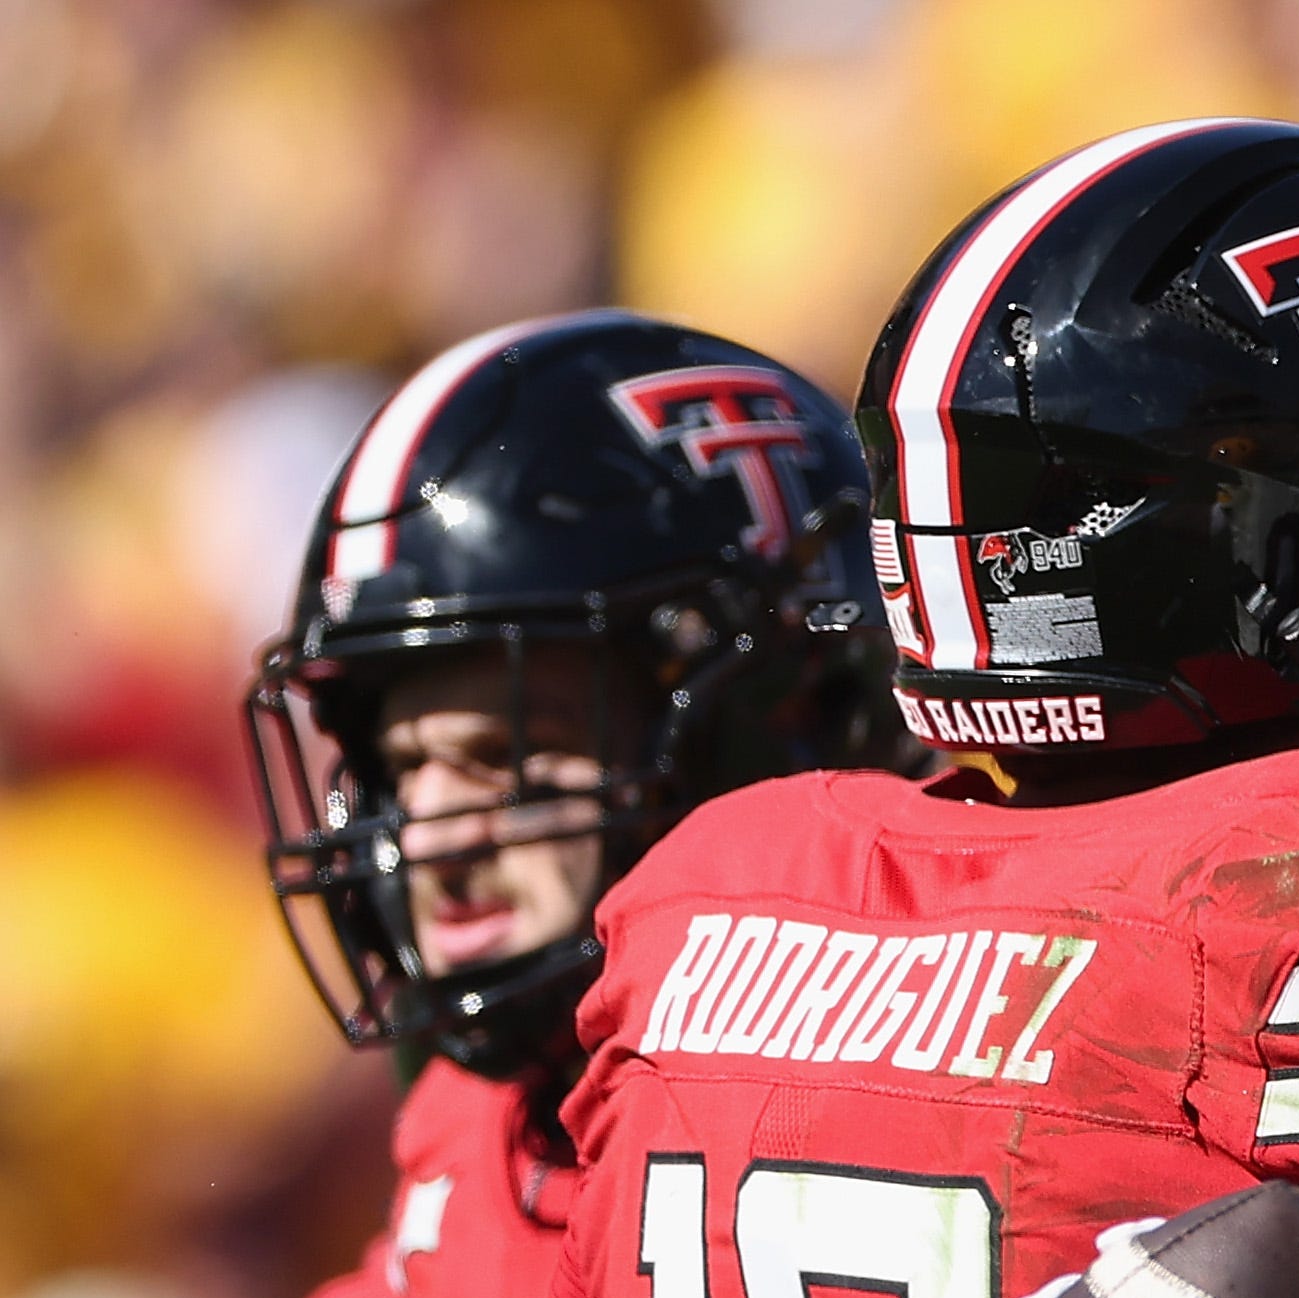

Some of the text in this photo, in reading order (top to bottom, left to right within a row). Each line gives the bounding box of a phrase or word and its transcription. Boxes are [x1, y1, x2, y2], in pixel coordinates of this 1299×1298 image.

[1029, 539, 1083, 572] 940
[924, 696, 1105, 744] RAIDERS
[640, 913, 1098, 1085] RODRIGUEZ
